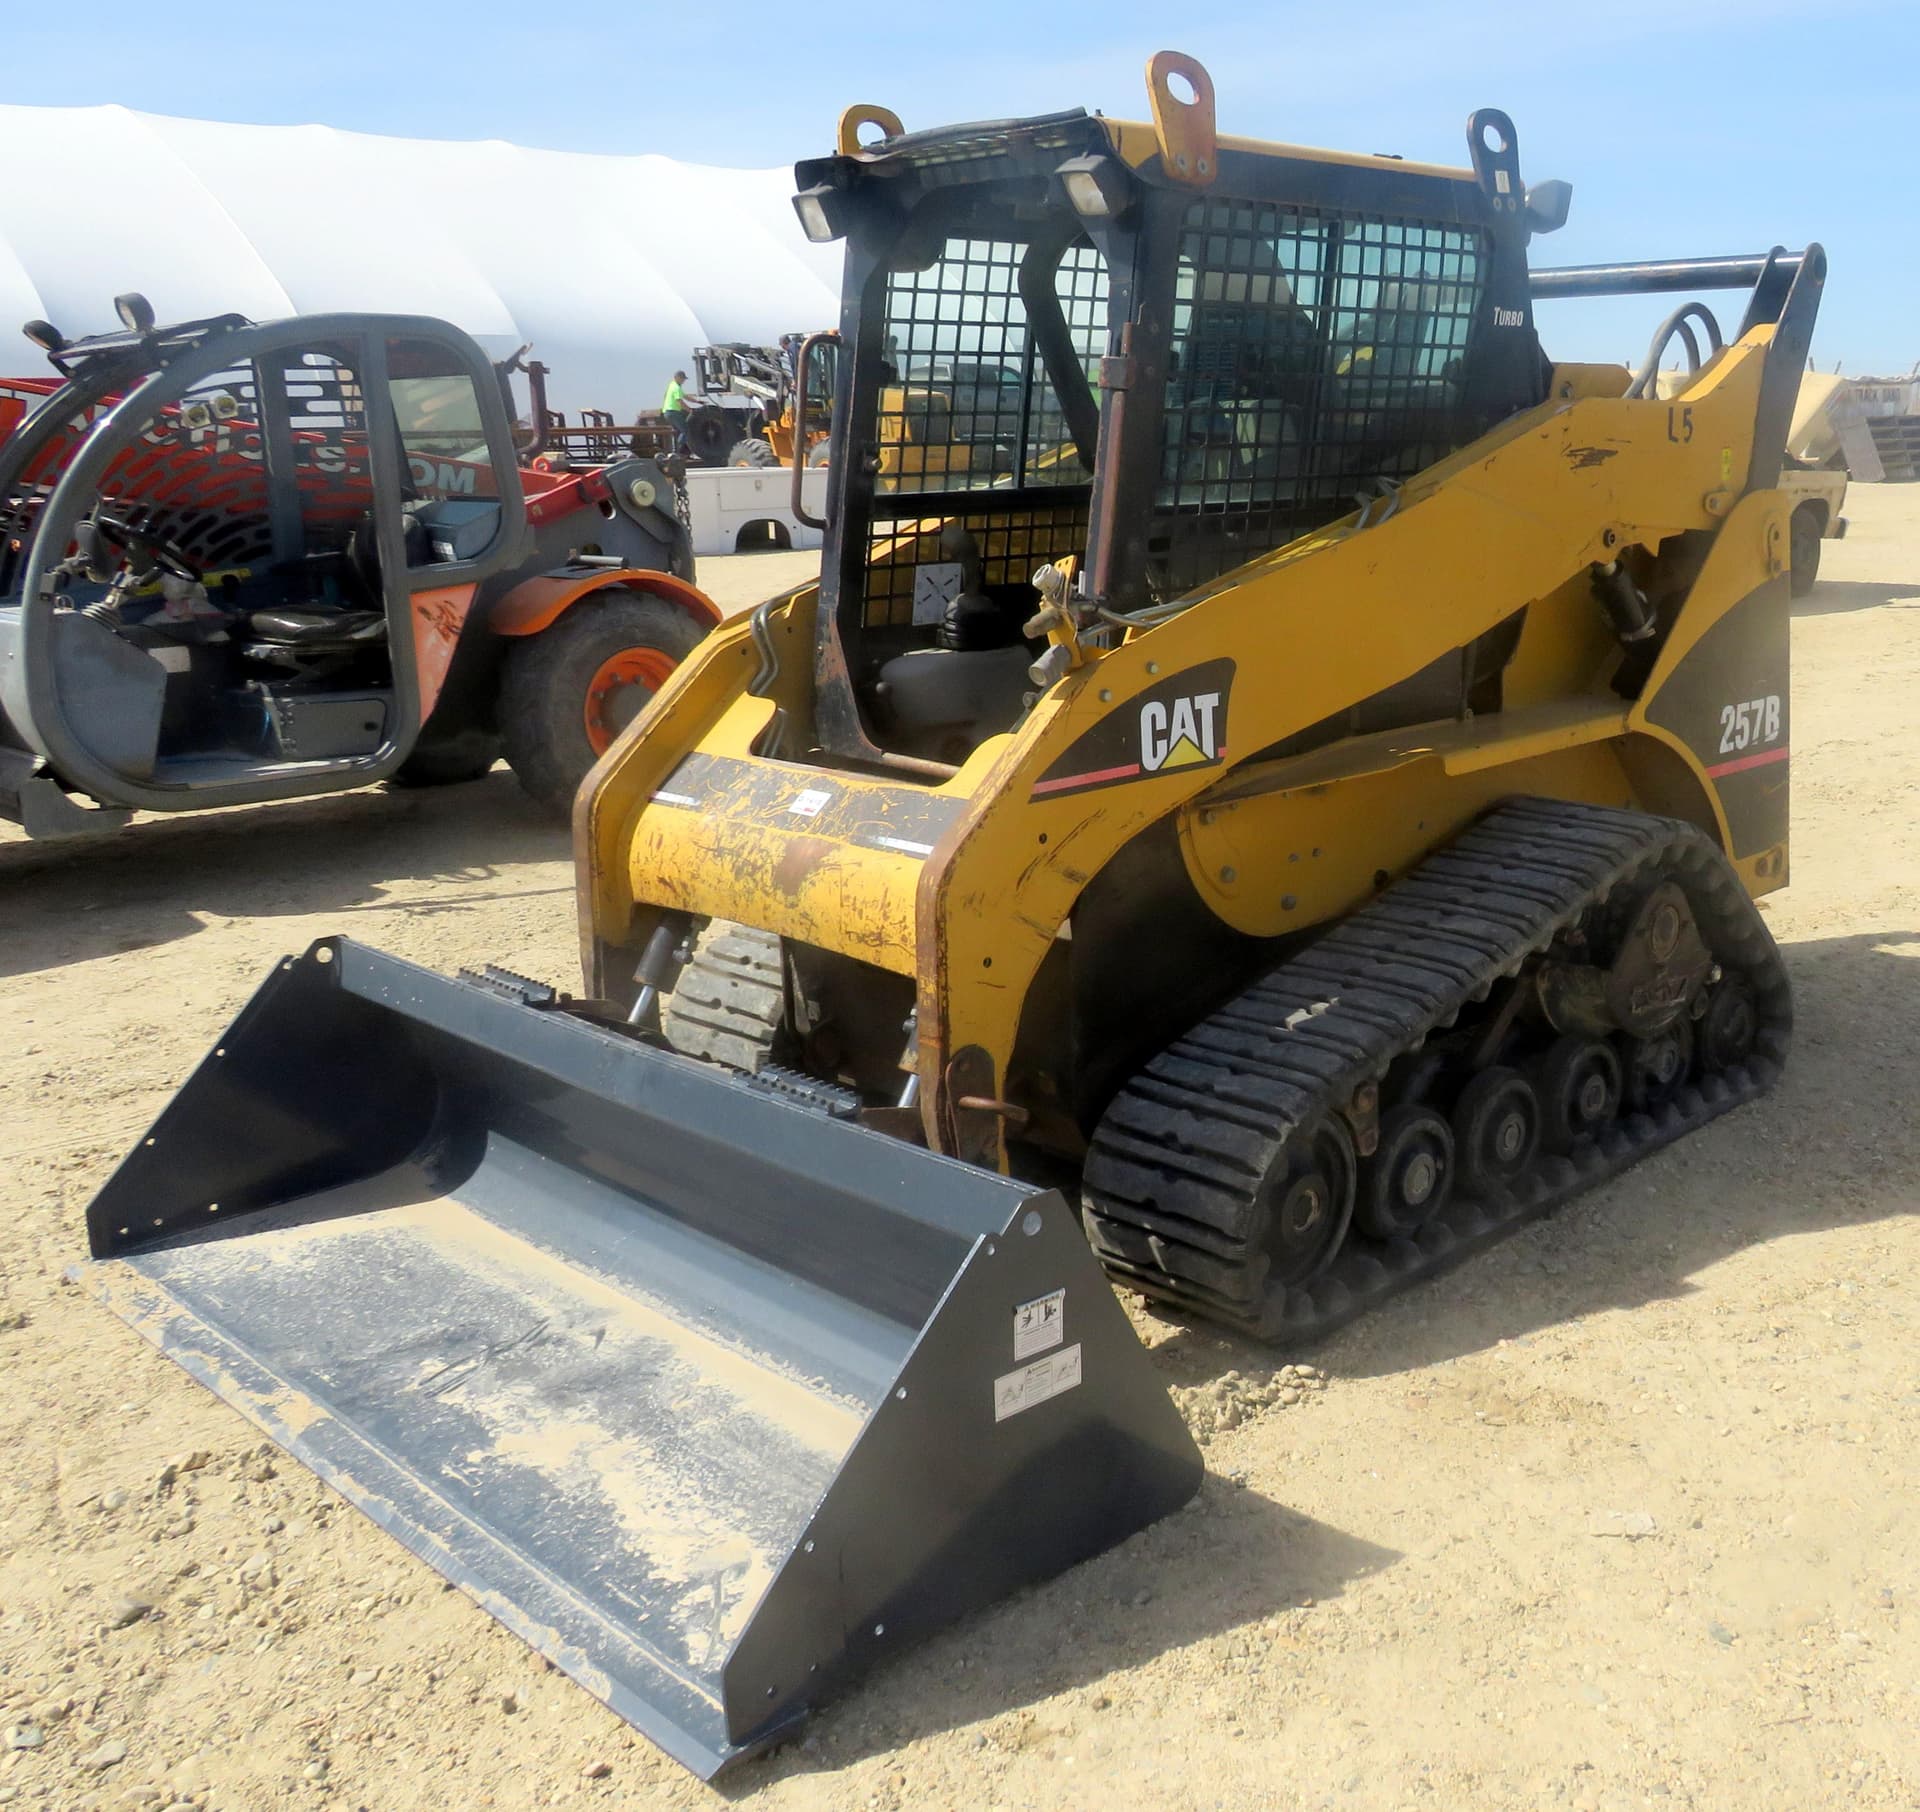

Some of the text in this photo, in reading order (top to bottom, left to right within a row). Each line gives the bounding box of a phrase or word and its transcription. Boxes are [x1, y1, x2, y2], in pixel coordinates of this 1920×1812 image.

[1494, 306, 1524, 327] TURBO
[1668, 406, 1694, 444] L5
[1140, 692, 1219, 771] CAT
[1720, 695, 1780, 754] 257B
